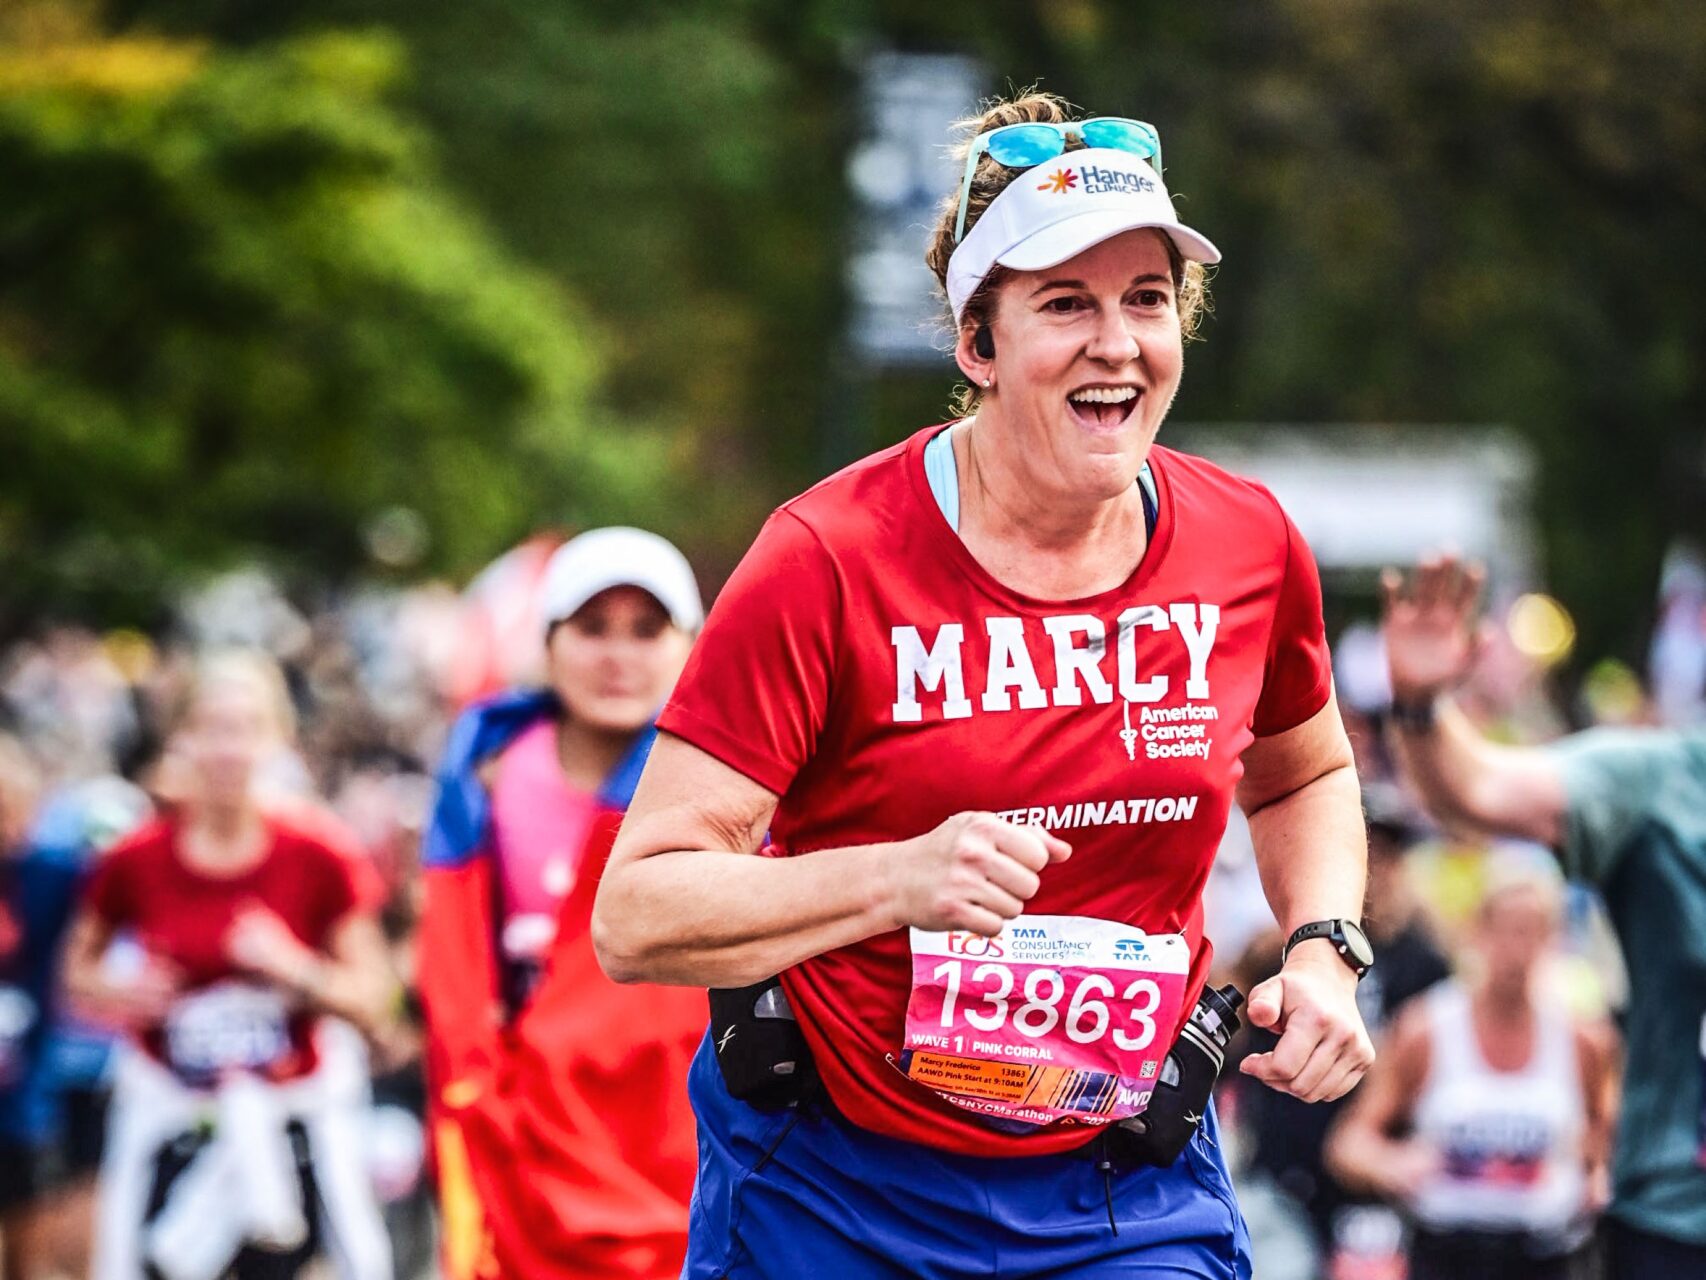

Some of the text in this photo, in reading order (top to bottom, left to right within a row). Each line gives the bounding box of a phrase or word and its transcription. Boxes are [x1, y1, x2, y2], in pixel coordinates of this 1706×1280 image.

[1080, 165, 1155, 193] Hanger
[891, 603, 1221, 723] MARCY
[1140, 702, 1219, 724] American
[1141, 724, 1206, 741] Cancer
[1145, 739, 1212, 760] Society
[992, 795, 1199, 831] TERMINATION
[1011, 928, 1047, 938] TATA
[1011, 940, 1092, 951] CONSULTANCY
[1011, 951, 1065, 960] SERVICES
[1113, 952, 1151, 961] TATA
[932, 960, 1162, 1052] 13863
[911, 1033, 1054, 1060] WAVE 1 PINK CORRAL
[920, 1056, 944, 1068] Marcy
[1001, 1068, 1026, 1078] 13863
[945, 1070, 962, 1080] Pink
[963, 1073, 982, 1083] Start
[984, 1076, 992, 1084] at
[1117, 1089, 1152, 1107] AWD
